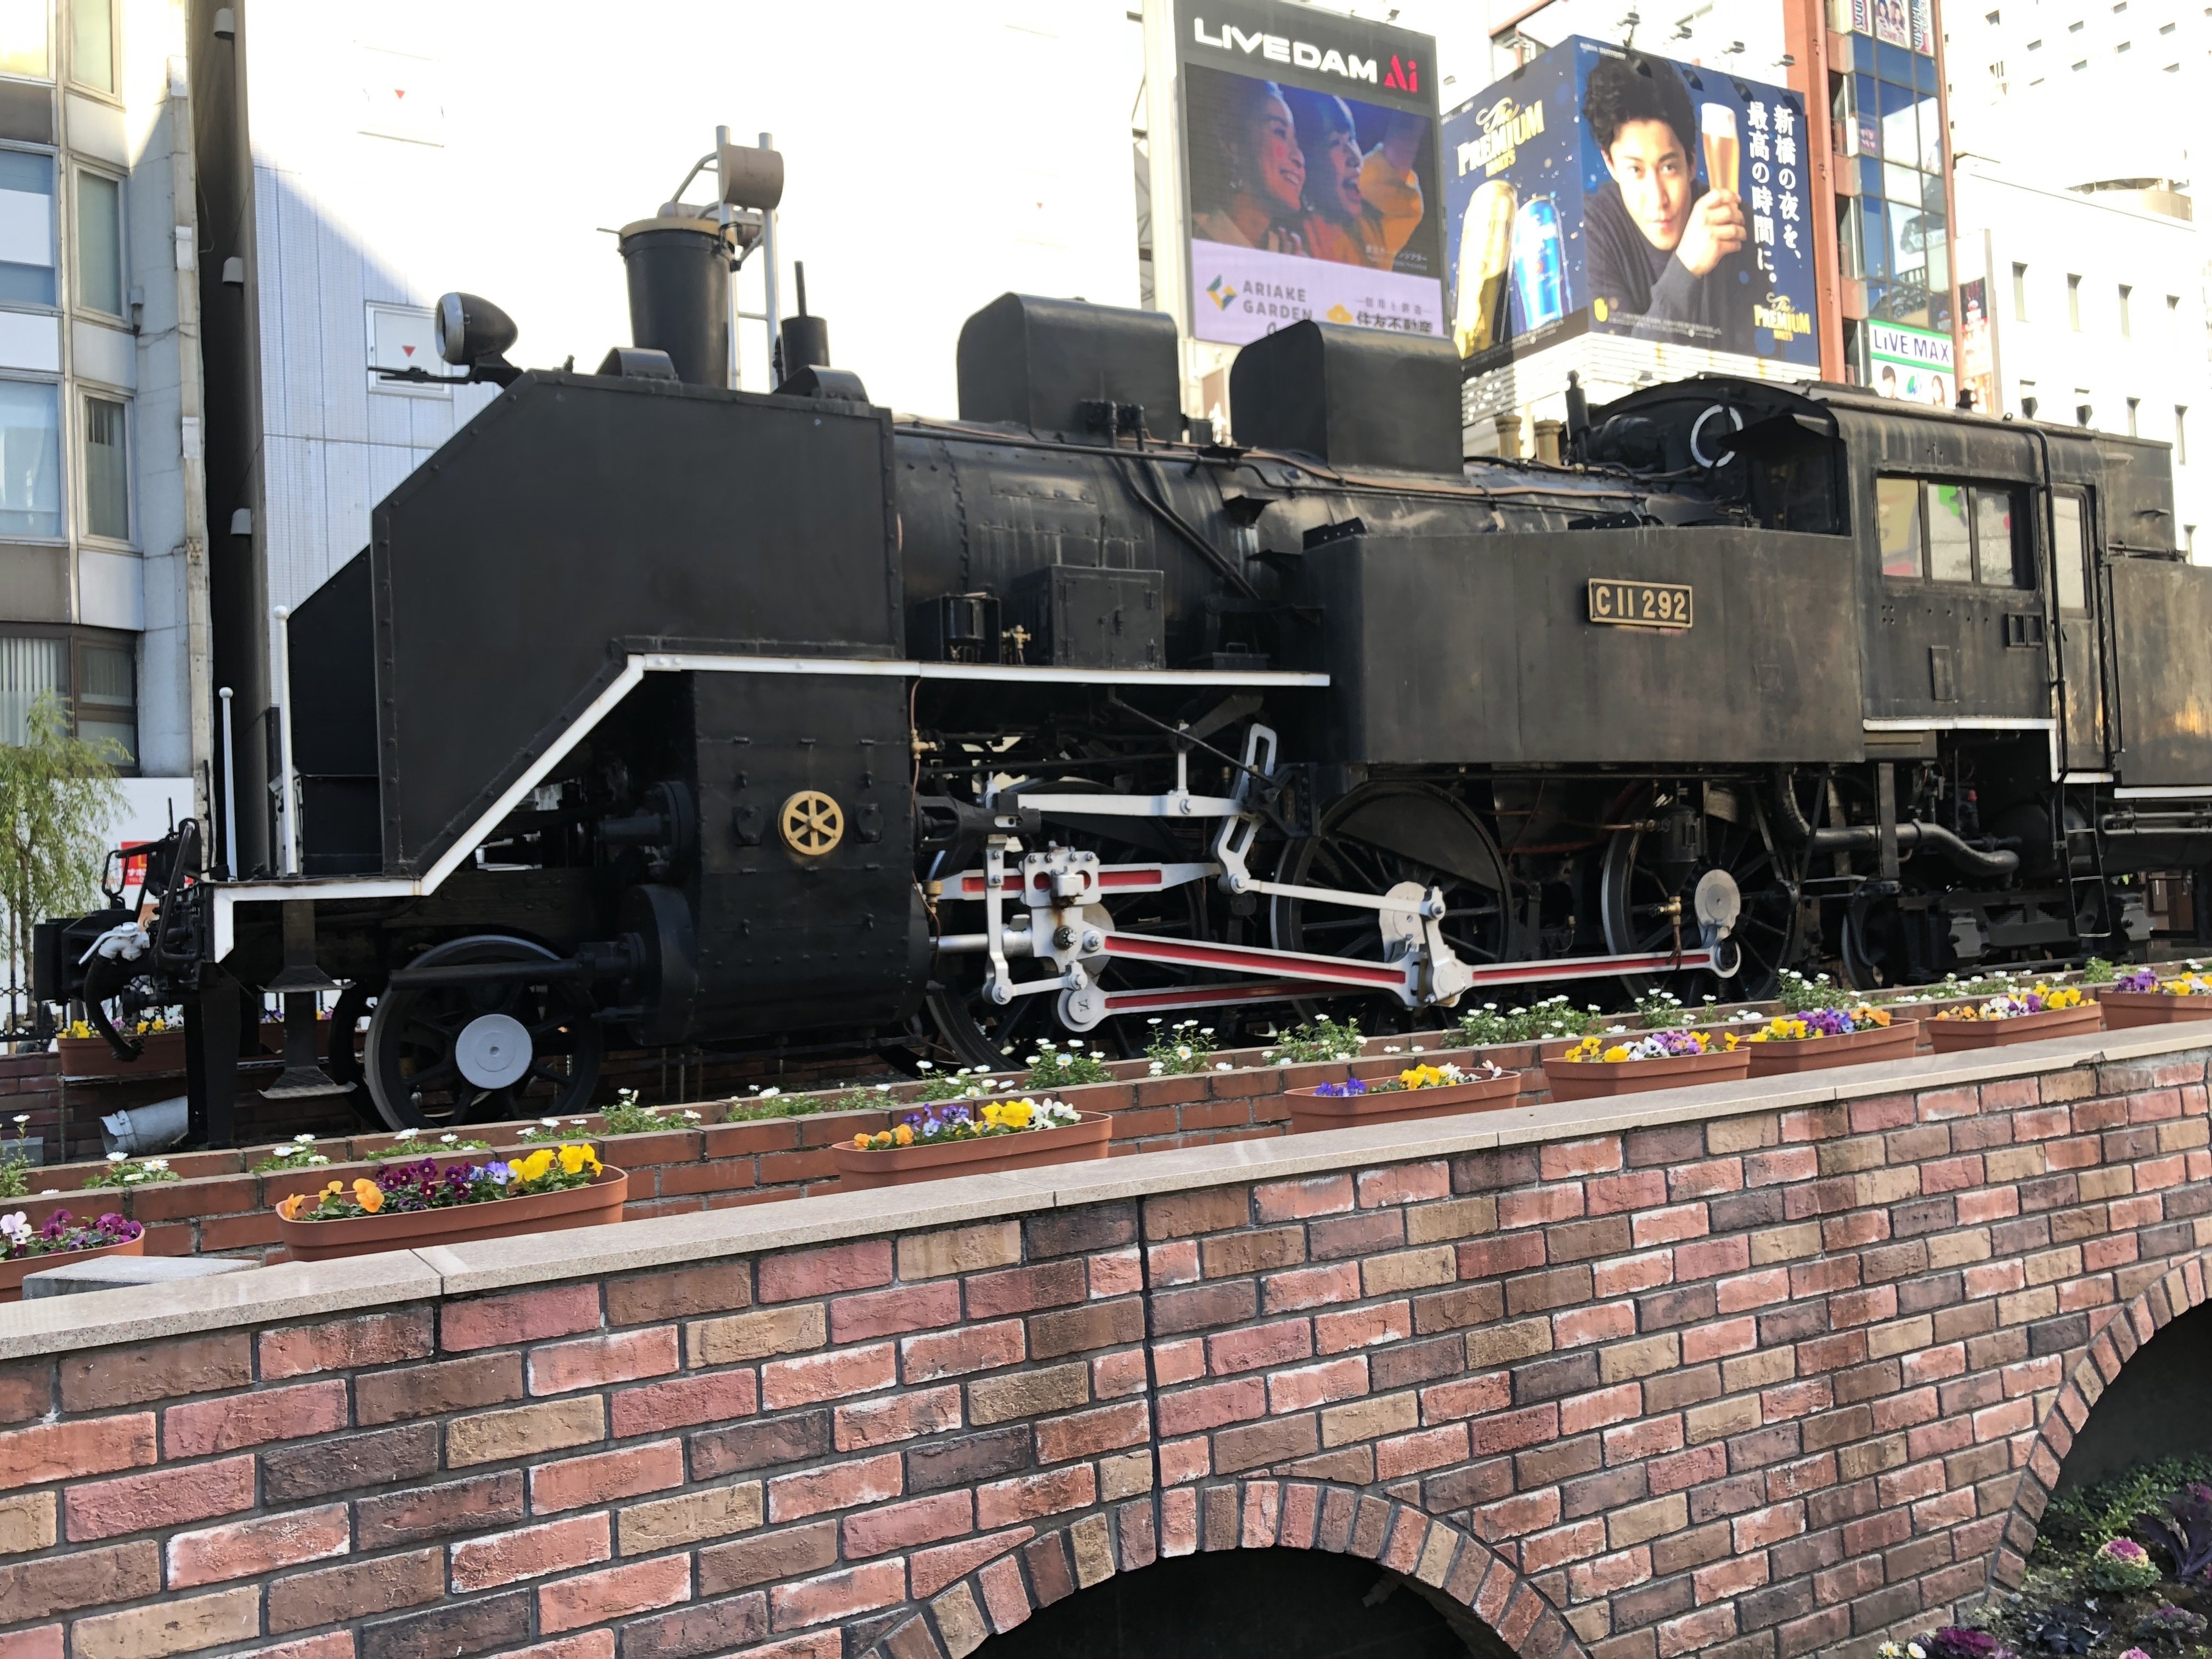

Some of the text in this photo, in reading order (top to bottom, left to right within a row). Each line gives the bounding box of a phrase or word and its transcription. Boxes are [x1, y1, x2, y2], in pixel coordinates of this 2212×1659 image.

[1457, 99, 1545, 177] PREMIUM
[1747, 101, 1778, 284] 最高の時間に。
[1774, 104, 1802, 259] 新橋の夜を、
[1243, 280, 1306, 302] ARIAKE
[1243, 300, 1312, 320] GARDEN
[1753, 304, 1811, 335] PREMIUM
[1914, 338, 1949, 362] MAX
[1642, 589, 1686, 621] 292
